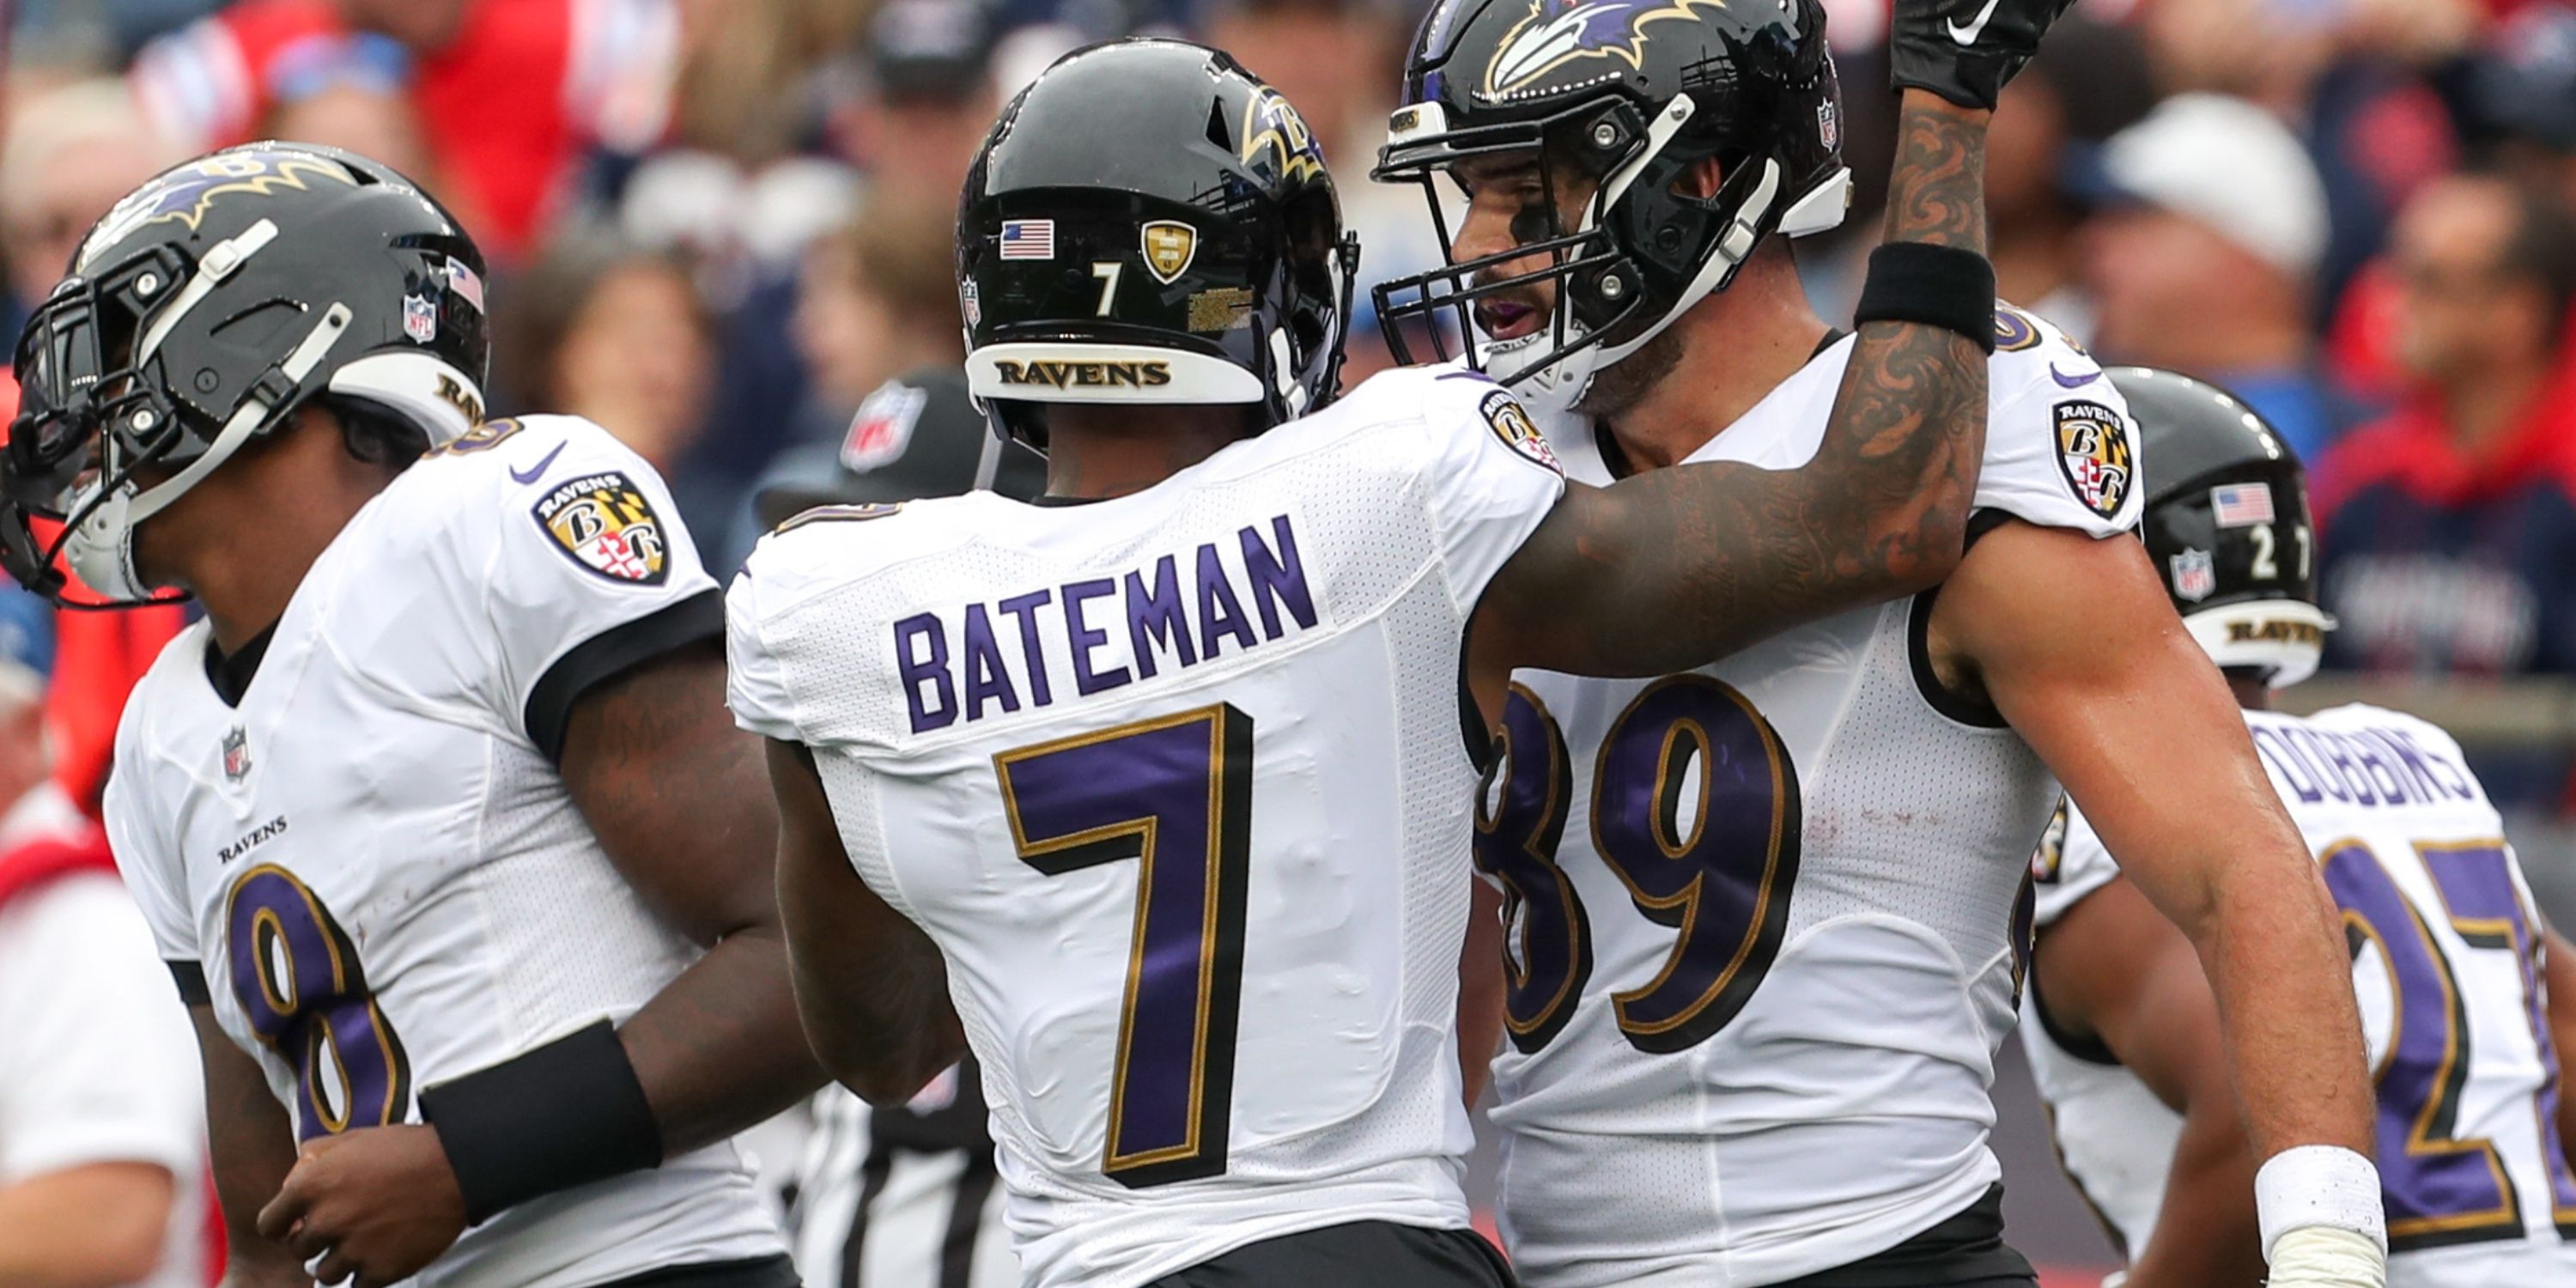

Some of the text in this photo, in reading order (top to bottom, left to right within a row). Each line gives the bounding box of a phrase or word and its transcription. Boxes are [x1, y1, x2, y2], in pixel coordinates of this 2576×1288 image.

[1091, 262, 1122, 317] 7
[410, 313, 433, 337] NFL
[993, 360, 1172, 391] RAVENS
[2059, 405, 2122, 430] RAVENS
[2060, 421, 2099, 455] B
[538, 474, 622, 519] RAVENS
[552, 499, 605, 550] B
[893, 513, 1319, 735] BATEMAN
[2250, 724, 2474, 807] DOBBINS
[216, 814, 288, 865] RAVENS
[1472, 672, 1802, 1054] 89
[992, 701, 1254, 1188] 7
[225, 862, 411, 1142] 8
